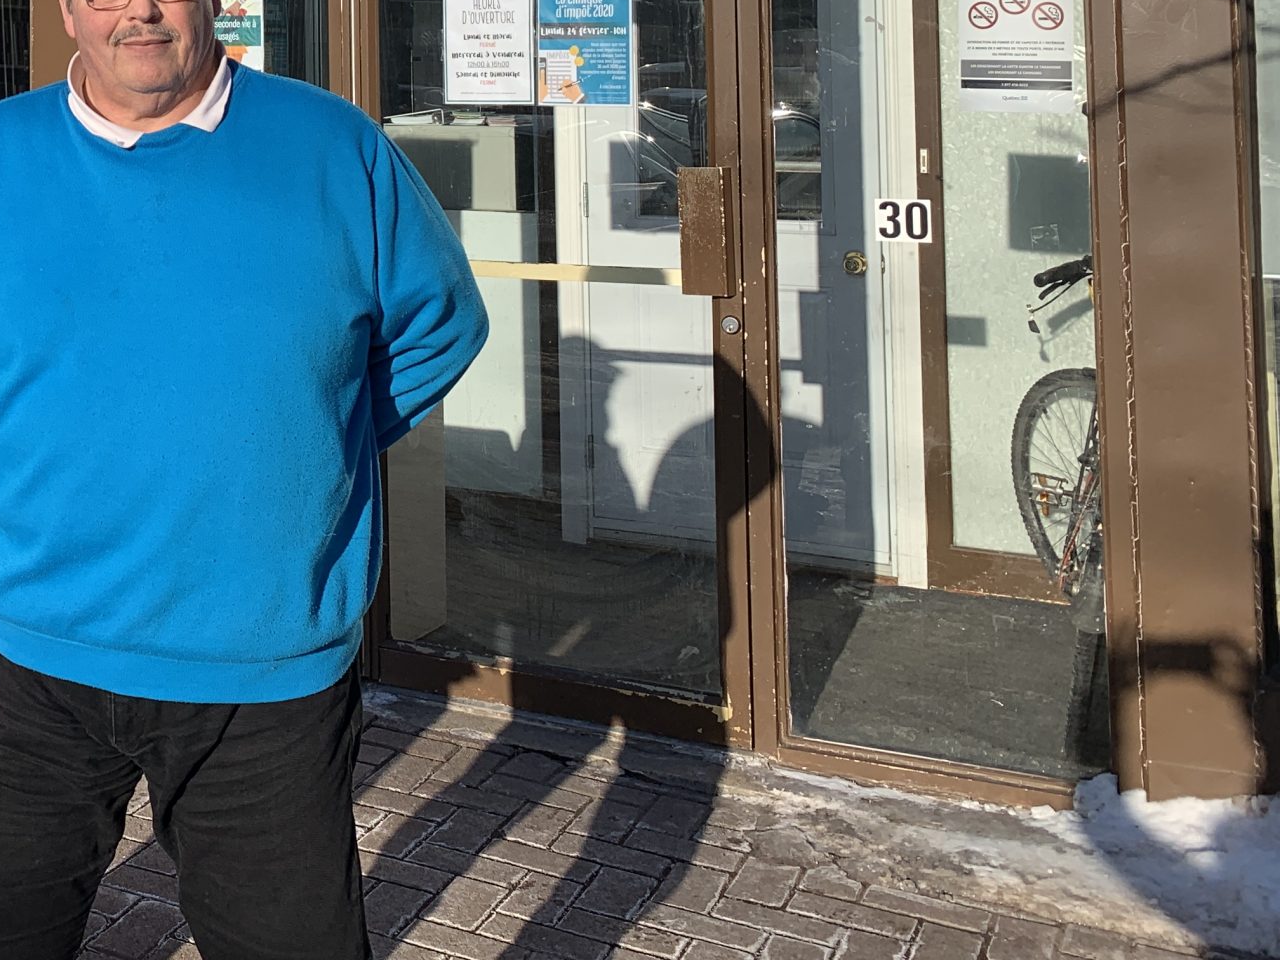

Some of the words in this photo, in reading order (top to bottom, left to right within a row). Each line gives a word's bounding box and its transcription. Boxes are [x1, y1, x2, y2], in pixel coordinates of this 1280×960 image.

[462, 10, 515, 25] D'OUVERTURE
[555, 5, 592, 19] d'impôt
[593, 3, 614, 18] 2020
[214, 19, 240, 28] seconde
[242, 18, 252, 28] vie
[252, 18, 257, 28] à
[540, 26, 565, 36] Lundi
[579, 25, 609, 36] février
[218, 32, 239, 43] usagés
[879, 201, 928, 240] 30
